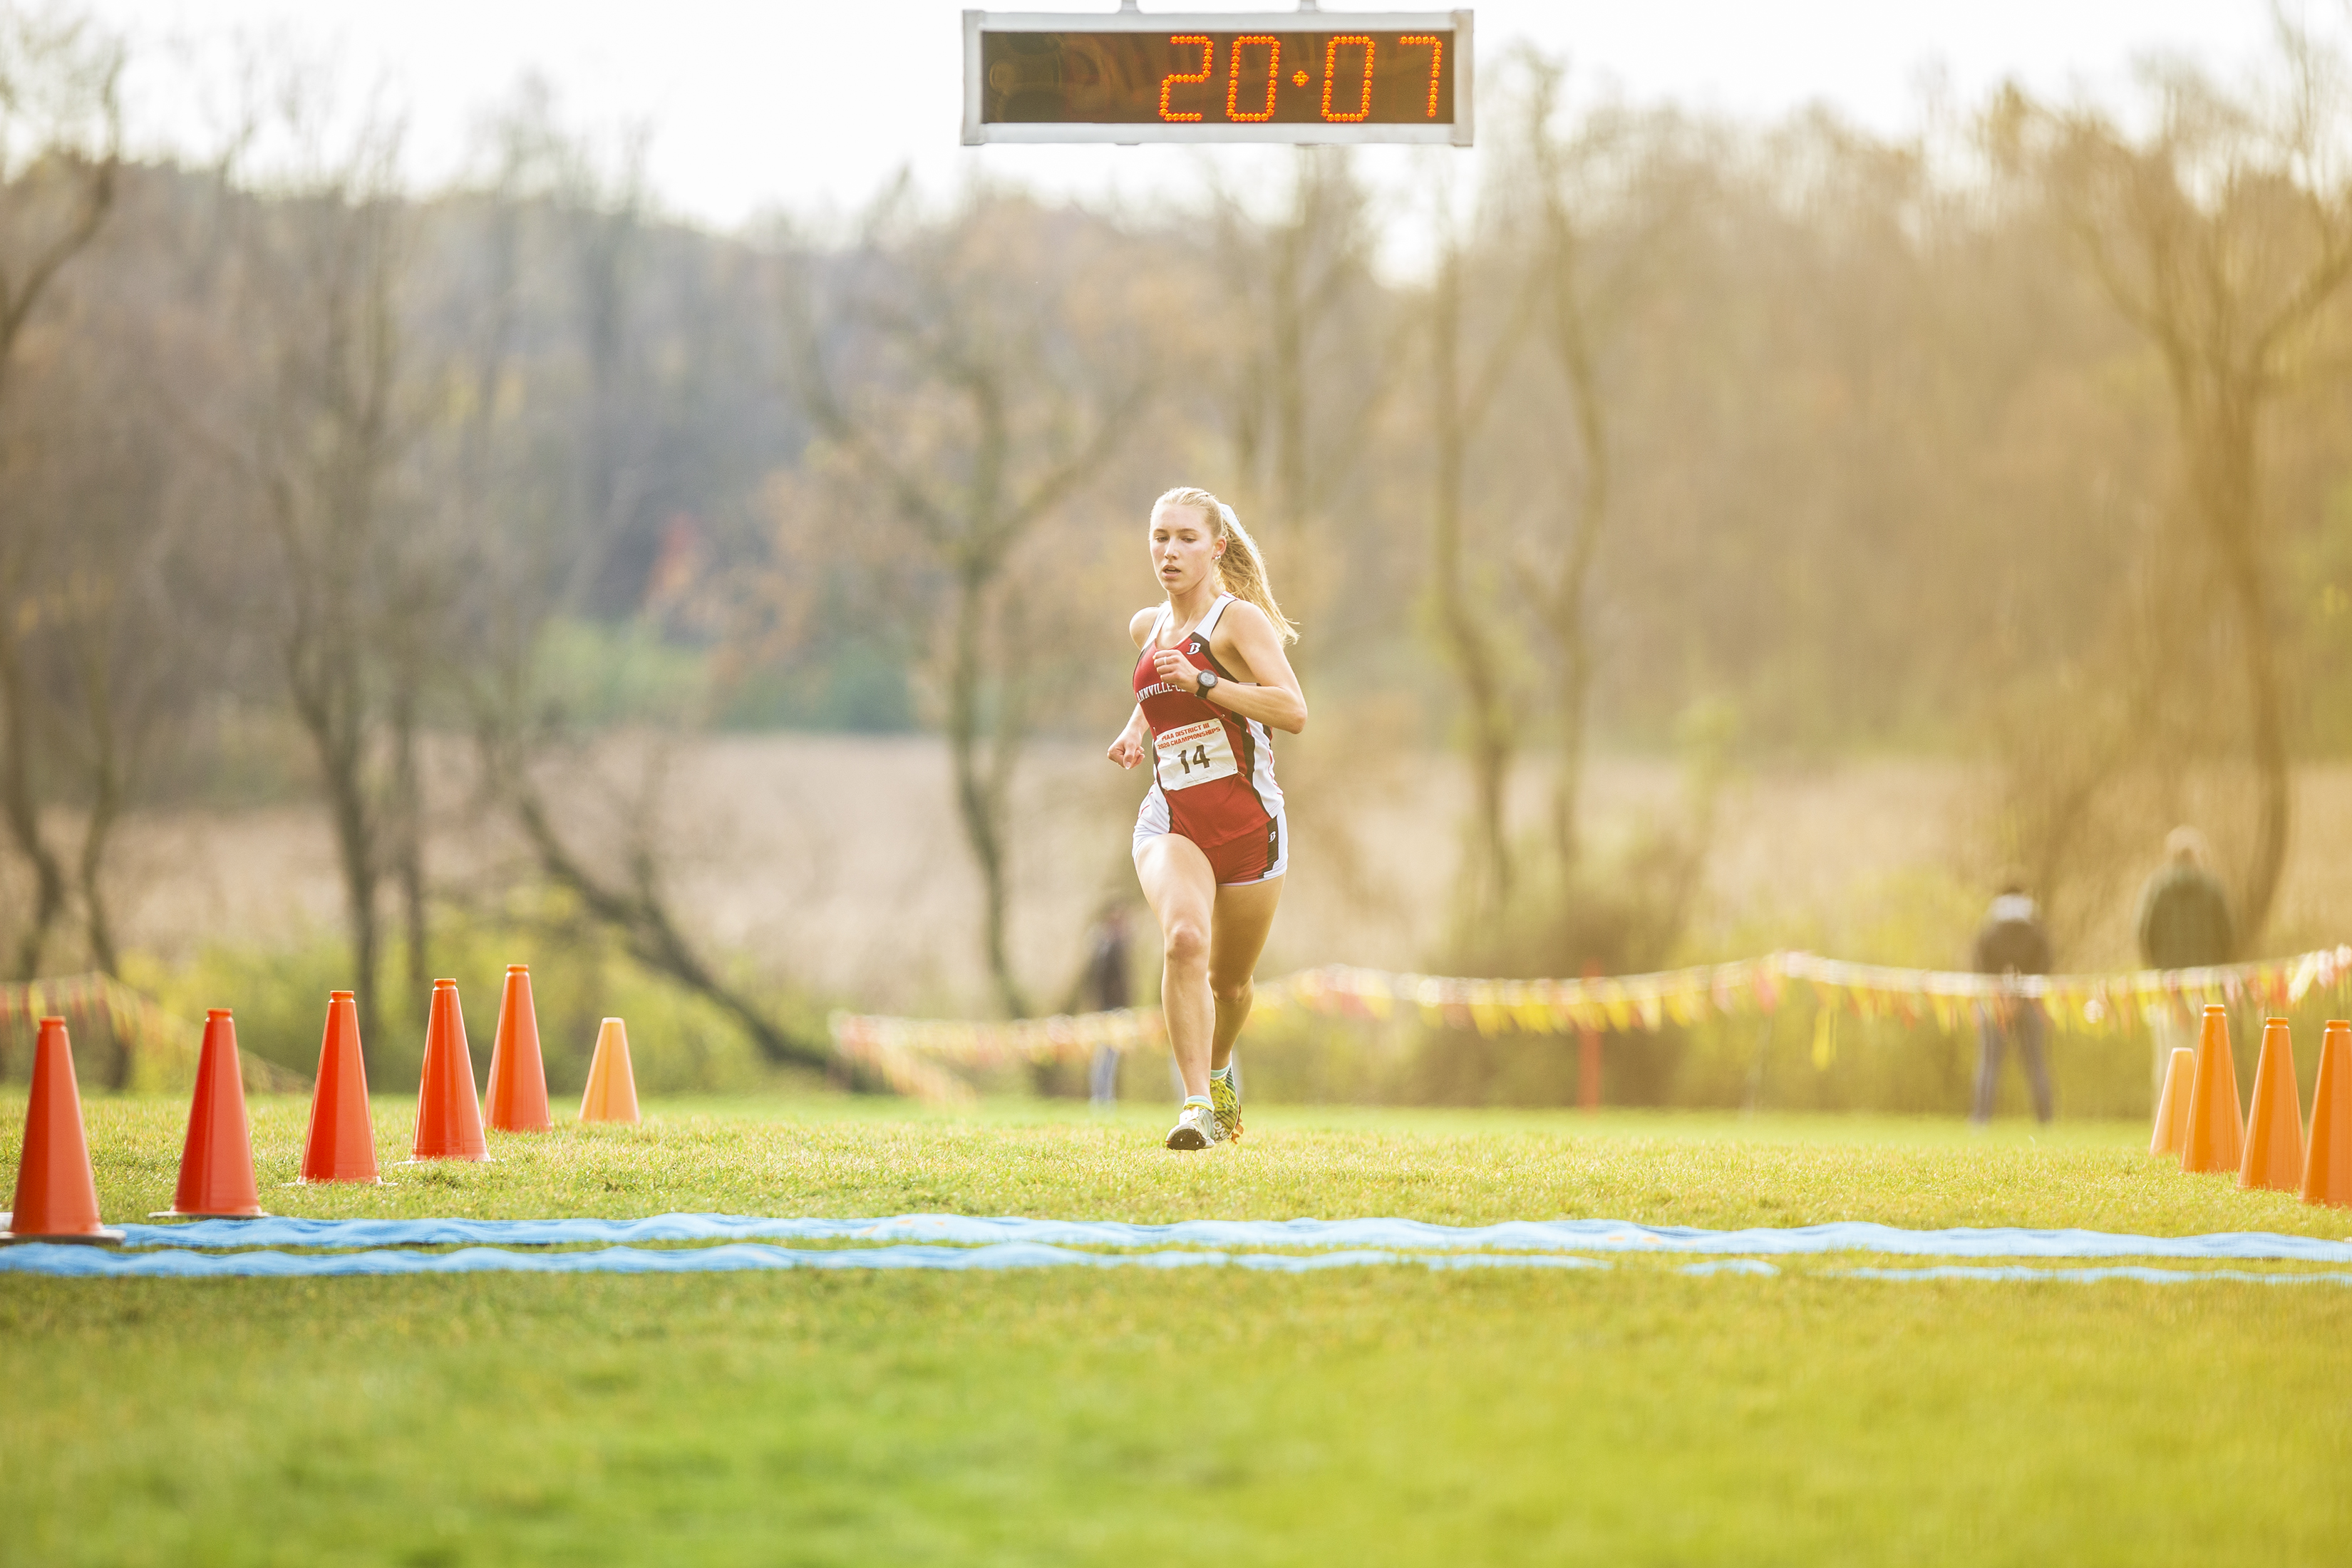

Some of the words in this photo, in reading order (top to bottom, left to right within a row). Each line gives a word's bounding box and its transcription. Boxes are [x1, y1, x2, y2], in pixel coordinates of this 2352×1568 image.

[1170, 727, 1221, 746] CHAMPIONSHIPS
[1175, 725, 1202, 737] DISTRICT
[1177, 745, 1210, 774] 14
